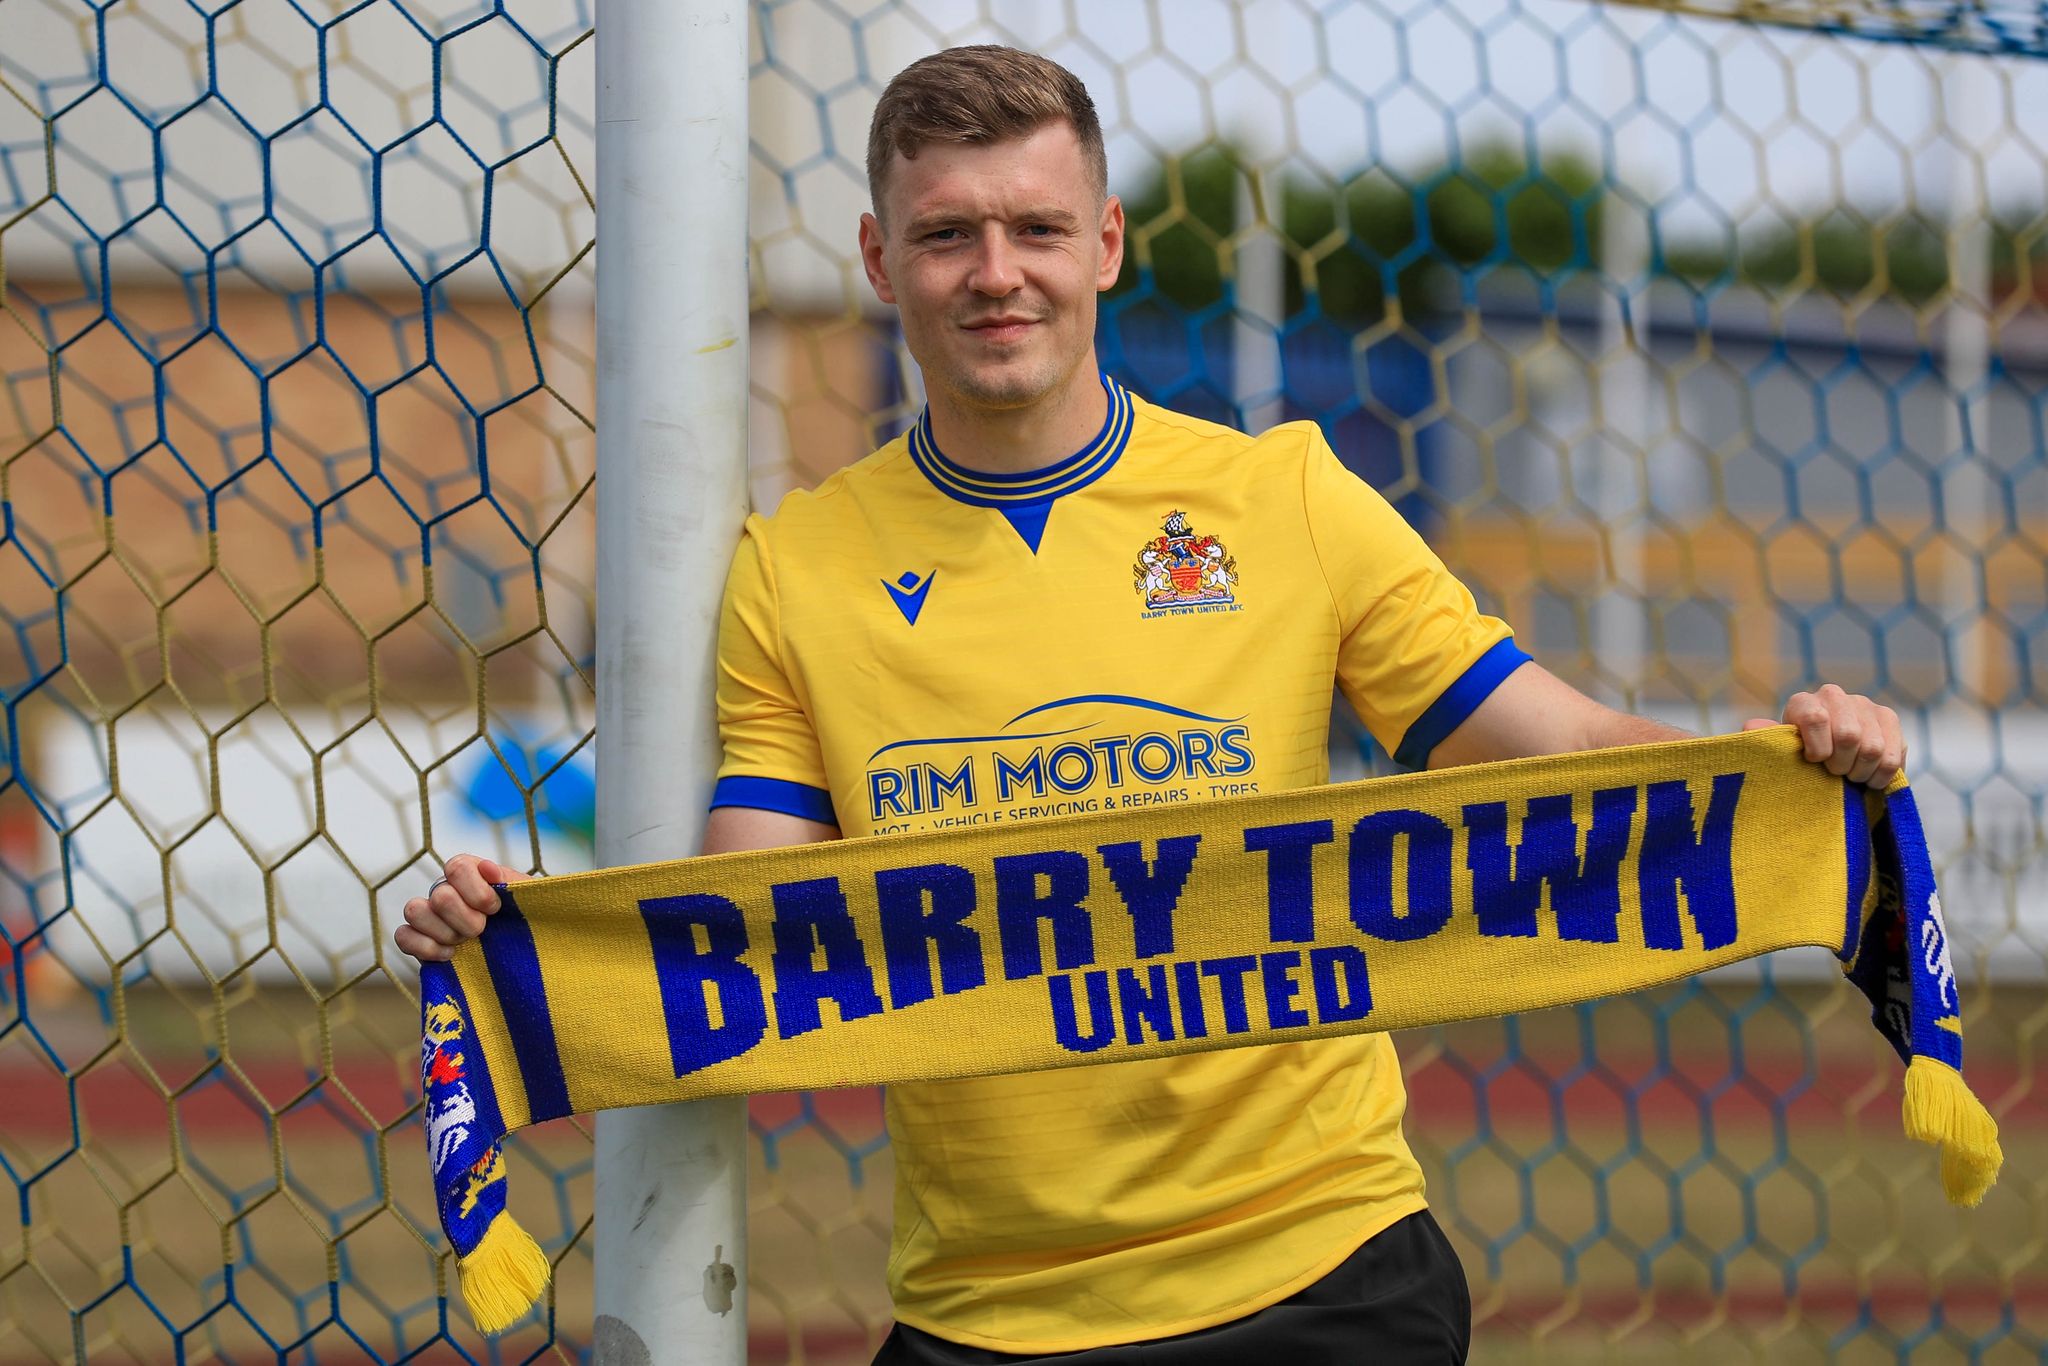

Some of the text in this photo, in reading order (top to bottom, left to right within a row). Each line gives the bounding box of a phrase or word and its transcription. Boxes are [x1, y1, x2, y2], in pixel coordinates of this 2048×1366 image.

[1141, 609, 1167, 619] BARRY
[1170, 607, 1195, 616] TOWN
[1197, 604, 1226, 613] UNITED
[867, 724, 1255, 821] RIM MOTORS
[1008, 799, 1098, 821] SERVICING
[1104, 796, 1116, 810] &
[1121, 788, 1189, 808] REPAIRS
[1208, 782, 1259, 798] TYRES
[638, 771, 1746, 1078] BARRY TOWN
[1048, 944, 1374, 1053] UNITED
